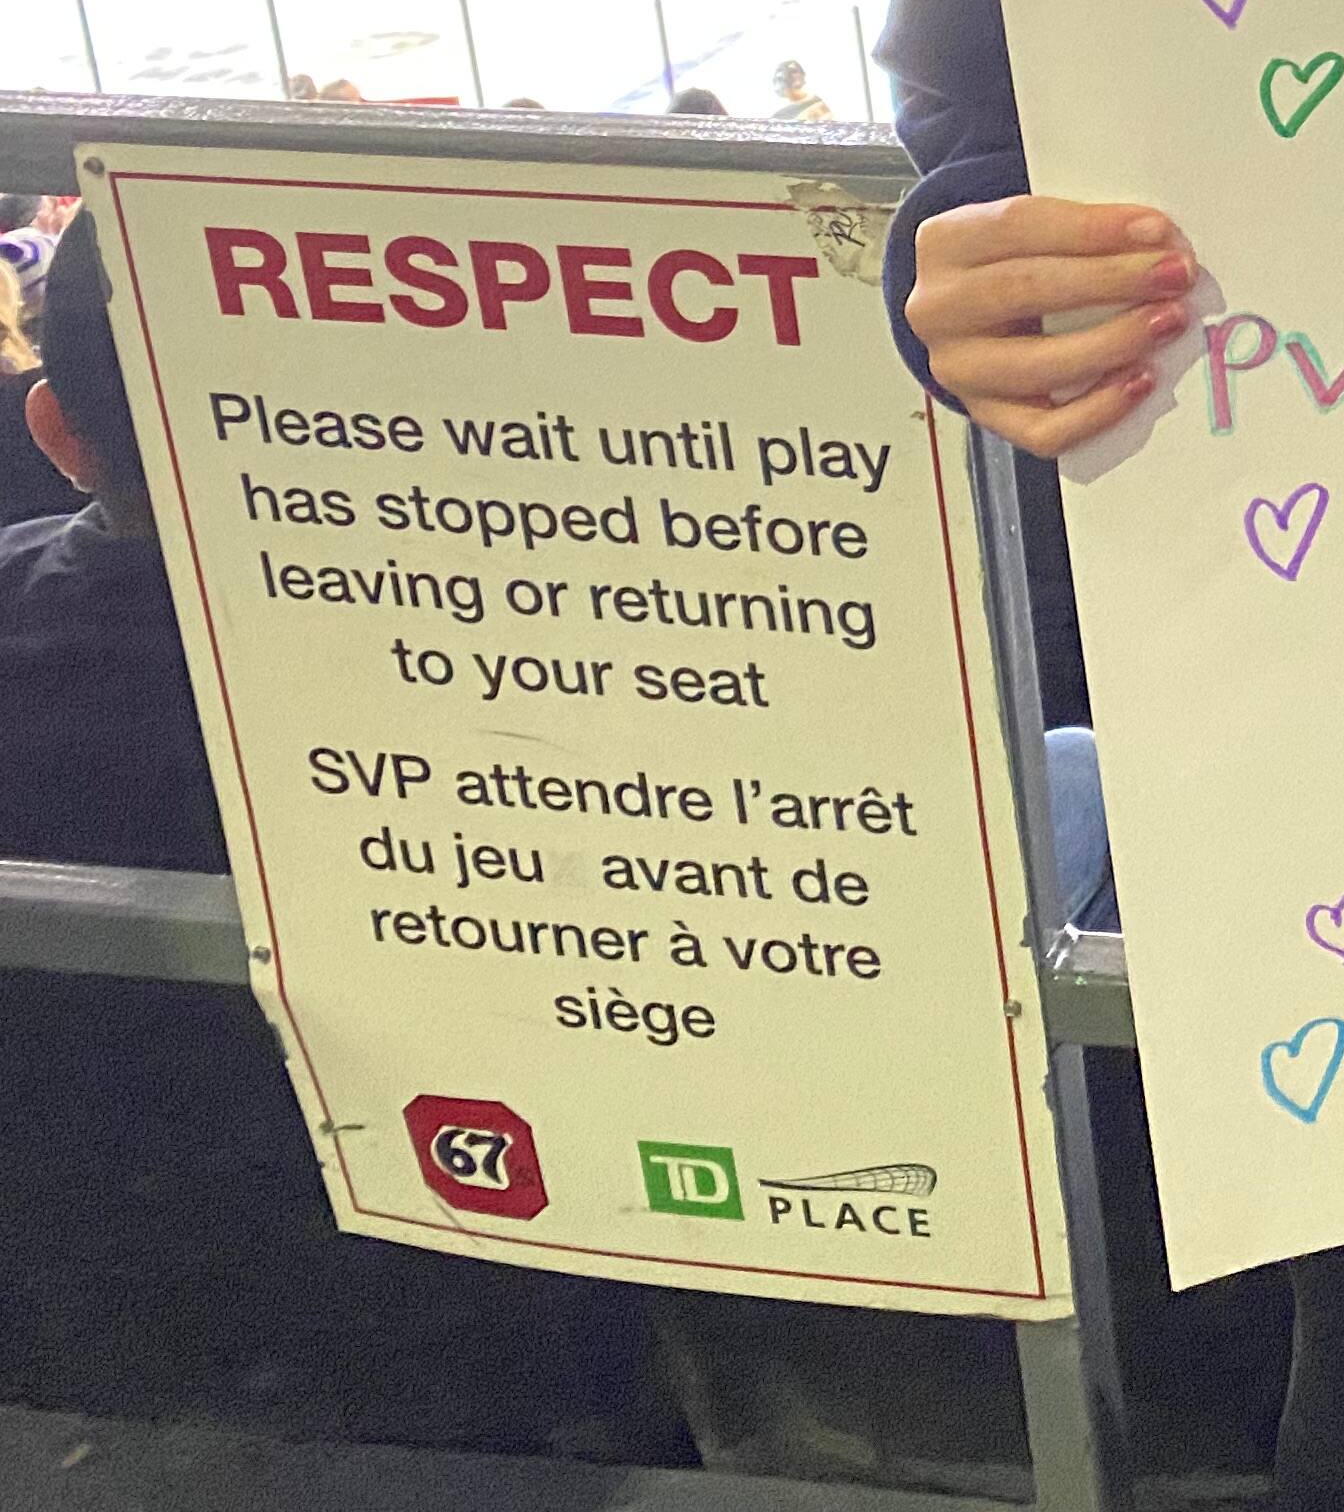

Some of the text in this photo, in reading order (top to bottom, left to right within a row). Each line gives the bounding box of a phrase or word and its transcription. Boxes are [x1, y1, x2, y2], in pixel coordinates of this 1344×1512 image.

[203, 226, 819, 347] RESPECT
[207, 391, 892, 493] Please wait until play
[240, 474, 869, 560] has stopped before
[260, 551, 877, 650] leaving or returning
[390, 638, 770, 708] to your seat
[307, 746, 918, 838] SVP attendre l'arrêt
[359, 826, 869, 907] du jeu avant de
[370, 905, 882, 979] retourner à votre
[553, 988, 716, 1046] siège
[431, 1123, 514, 1189] 67
[648, 1154, 730, 1207] TD
[768, 1196, 932, 1239] PLACE
